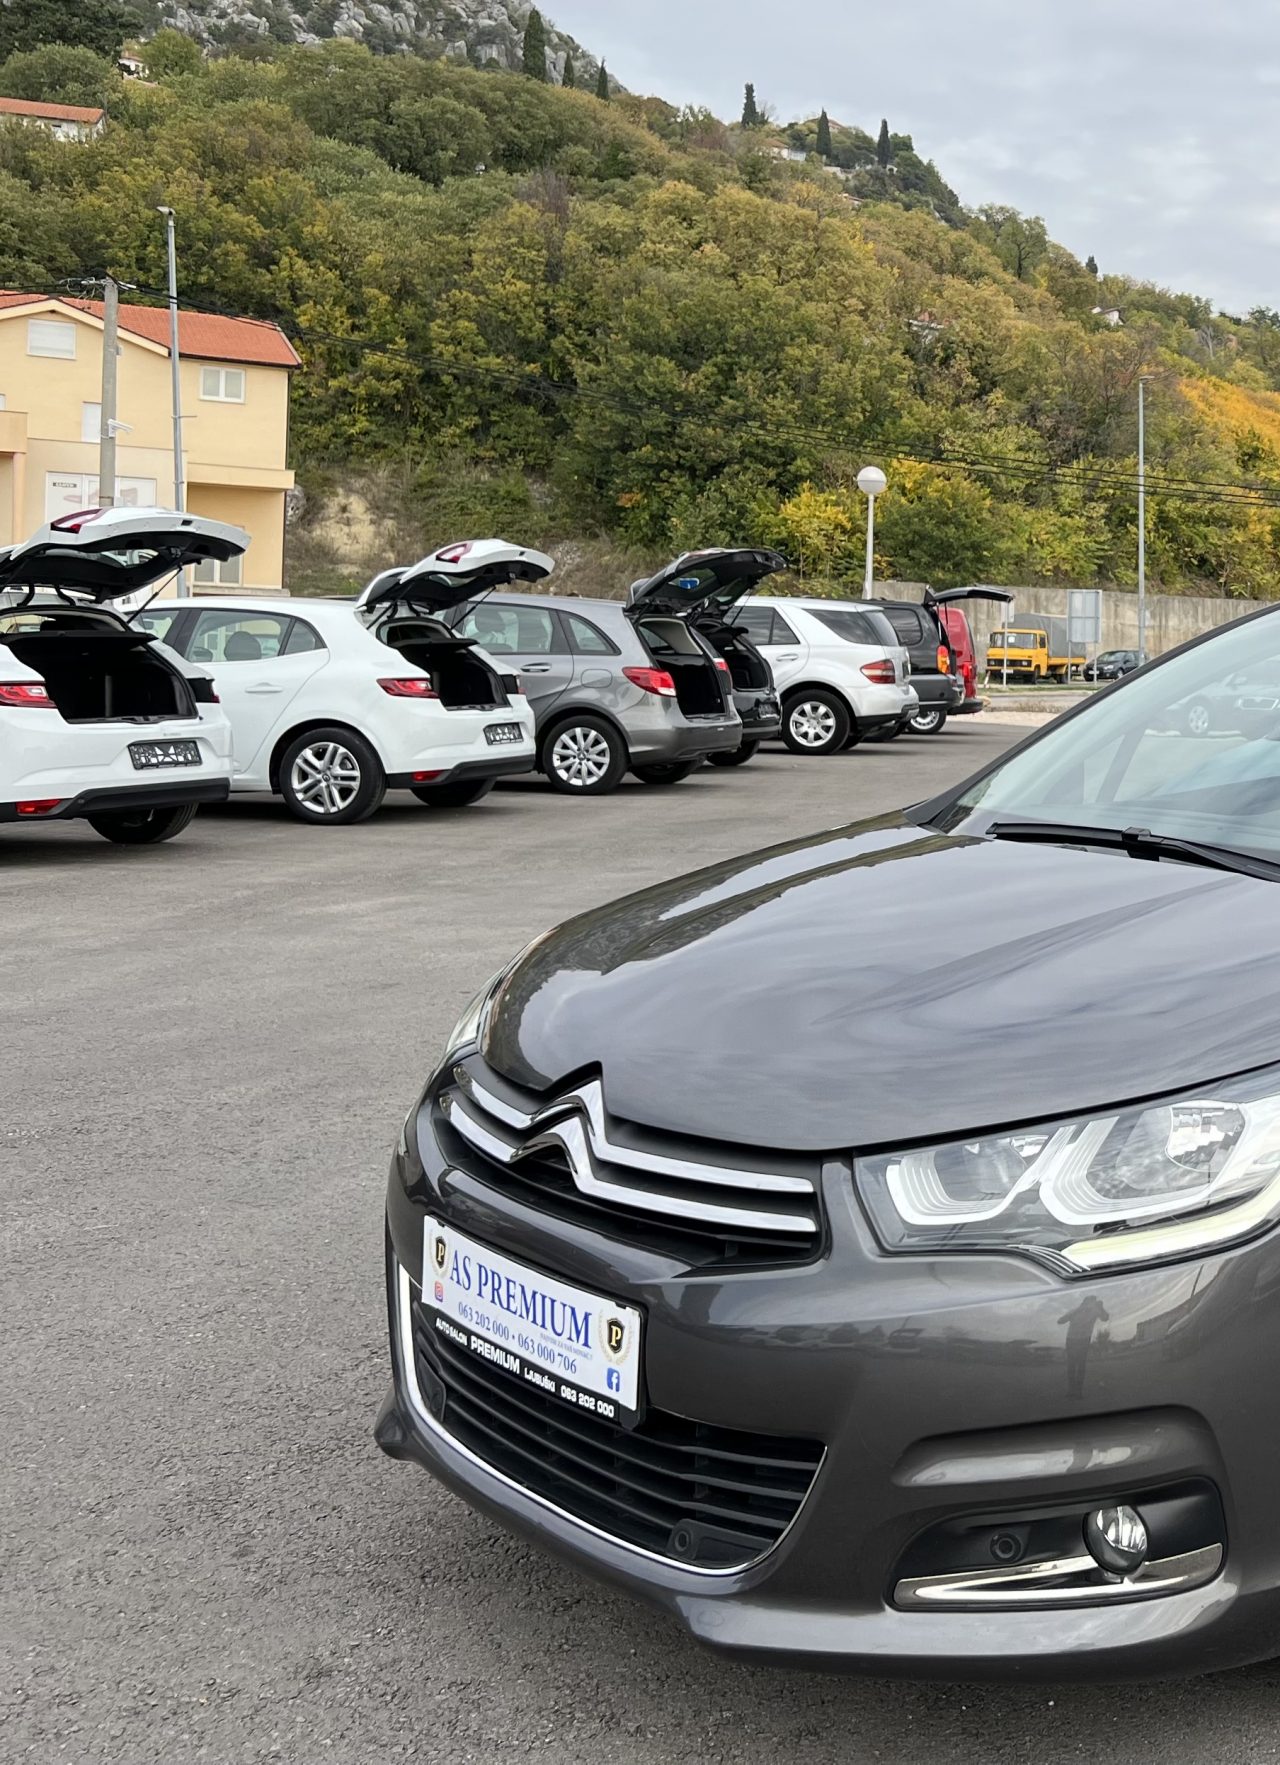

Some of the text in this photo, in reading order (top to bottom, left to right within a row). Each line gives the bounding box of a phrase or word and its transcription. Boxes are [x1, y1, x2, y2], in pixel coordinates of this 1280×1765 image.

[450, 1250, 593, 1350] AS PREMIUM
[458, 1301, 577, 1375] 063 202 000 063 000 706
[470, 1335, 520, 1375] PREMIUM
[578, 1393, 596, 1410] 202
[596, 1400, 615, 1418] 000
